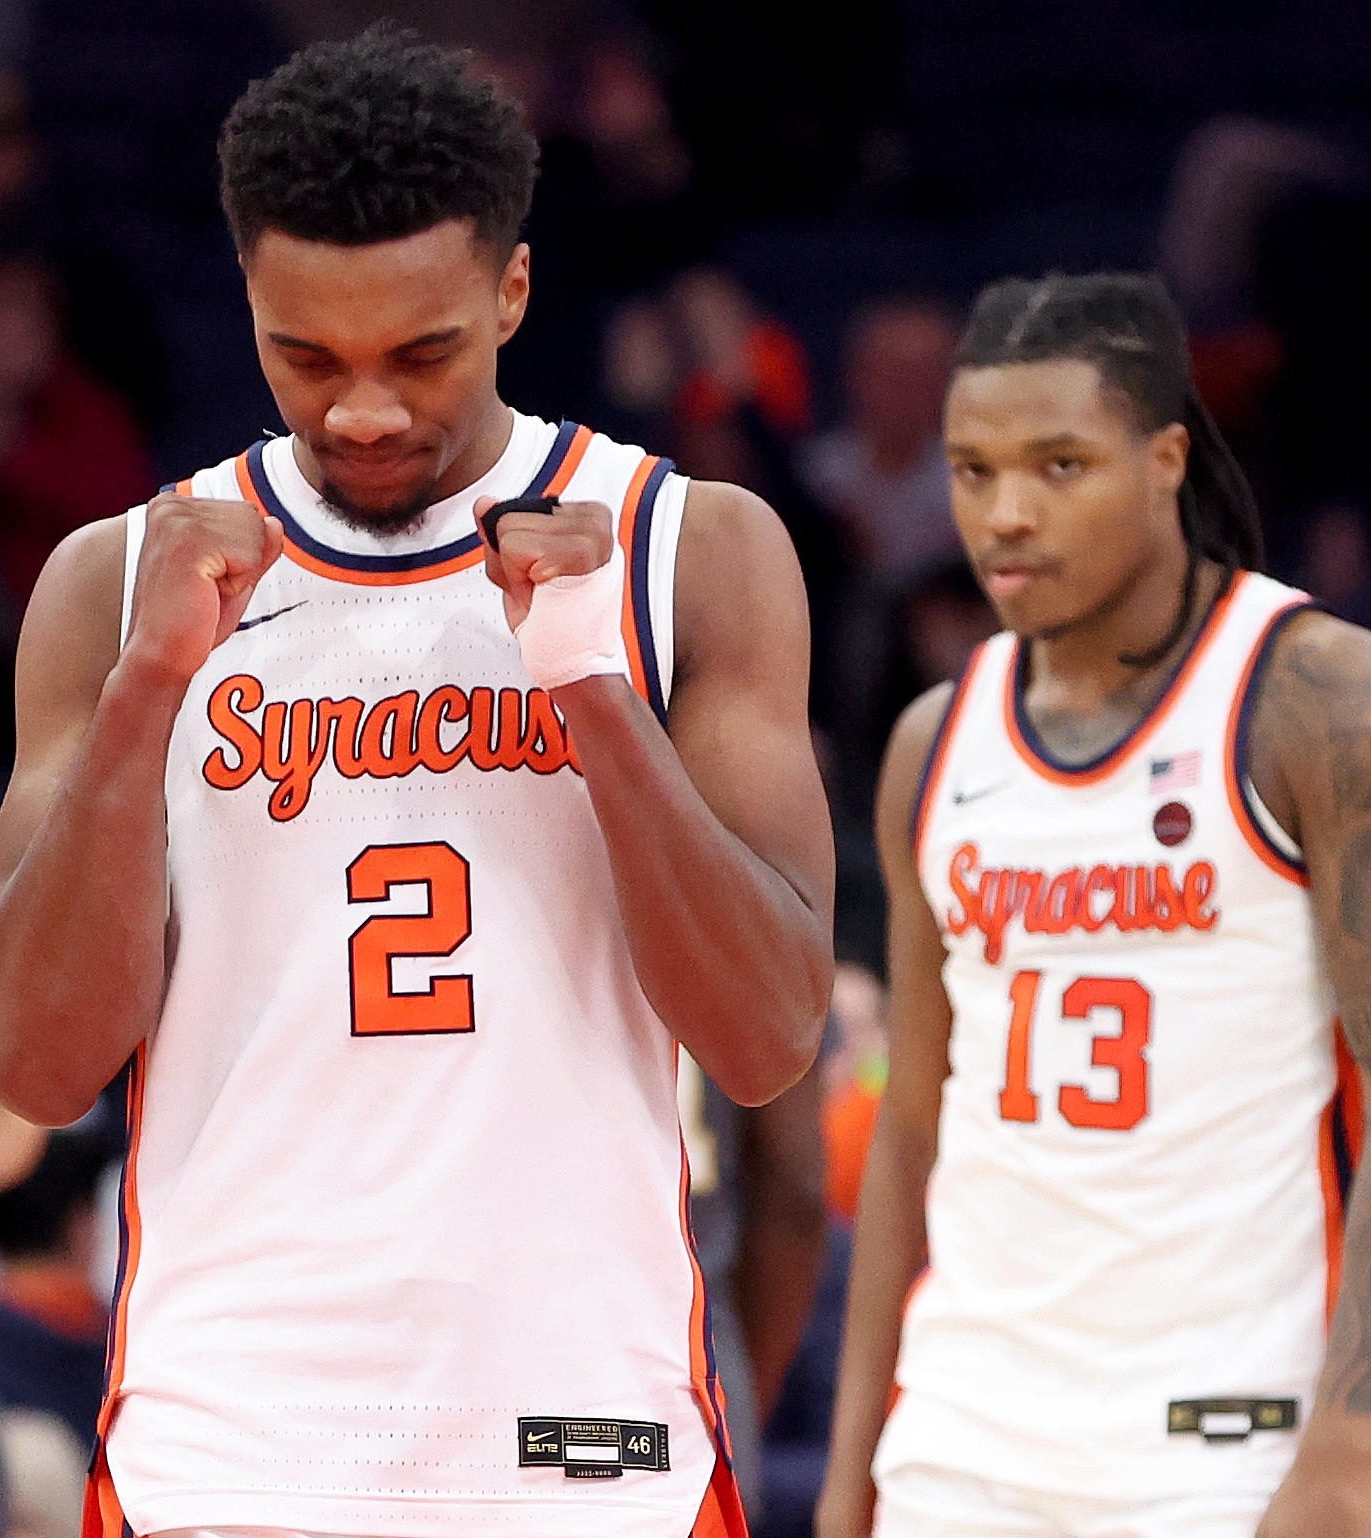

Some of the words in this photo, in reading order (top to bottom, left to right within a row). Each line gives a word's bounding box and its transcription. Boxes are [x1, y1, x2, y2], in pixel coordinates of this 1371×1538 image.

[345, 840, 476, 1037] 2
[945, 840, 1221, 966] Syracuse
[997, 968, 1152, 1131] 13
[526, 1443, 559, 1453] ELITE
[626, 1435, 651, 1455] 46
